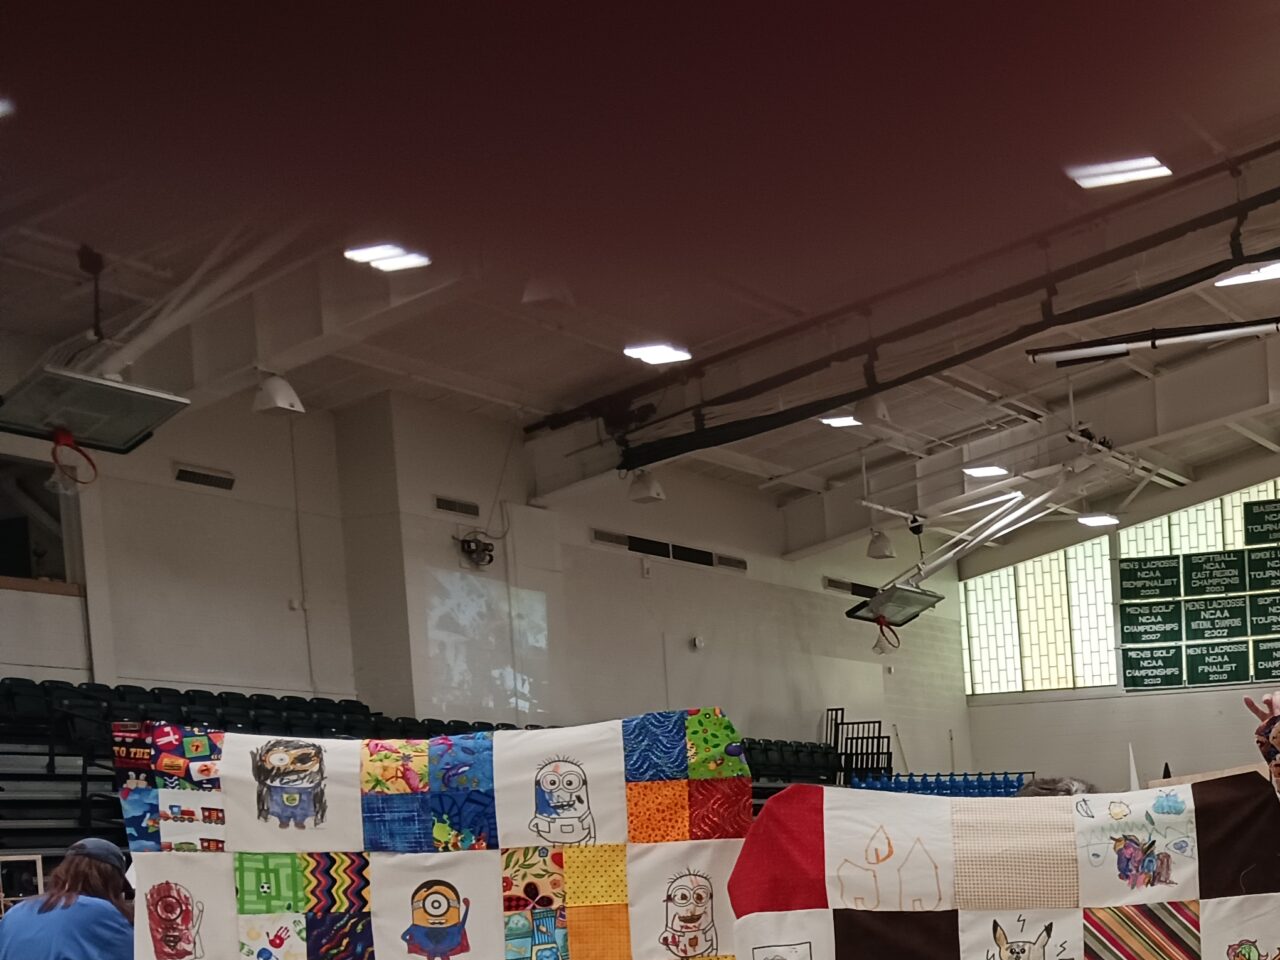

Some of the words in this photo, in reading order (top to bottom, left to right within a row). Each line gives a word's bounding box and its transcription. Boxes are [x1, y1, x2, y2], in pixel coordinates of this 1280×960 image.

[1192, 553, 1237, 563] SOFTBALL
[1192, 577, 1239, 587] CHAMPIONS
[1152, 605, 1175, 613] GOLF
[1139, 615, 1163, 623] NCAA
[1124, 623, 1178, 632] CHAMPIONSHIPS
[1210, 644, 1247, 653] LACROSSE
[1198, 664, 1237, 673] FINALIST
[113, 746, 126, 757] TO
[130, 747, 151, 758] THE
